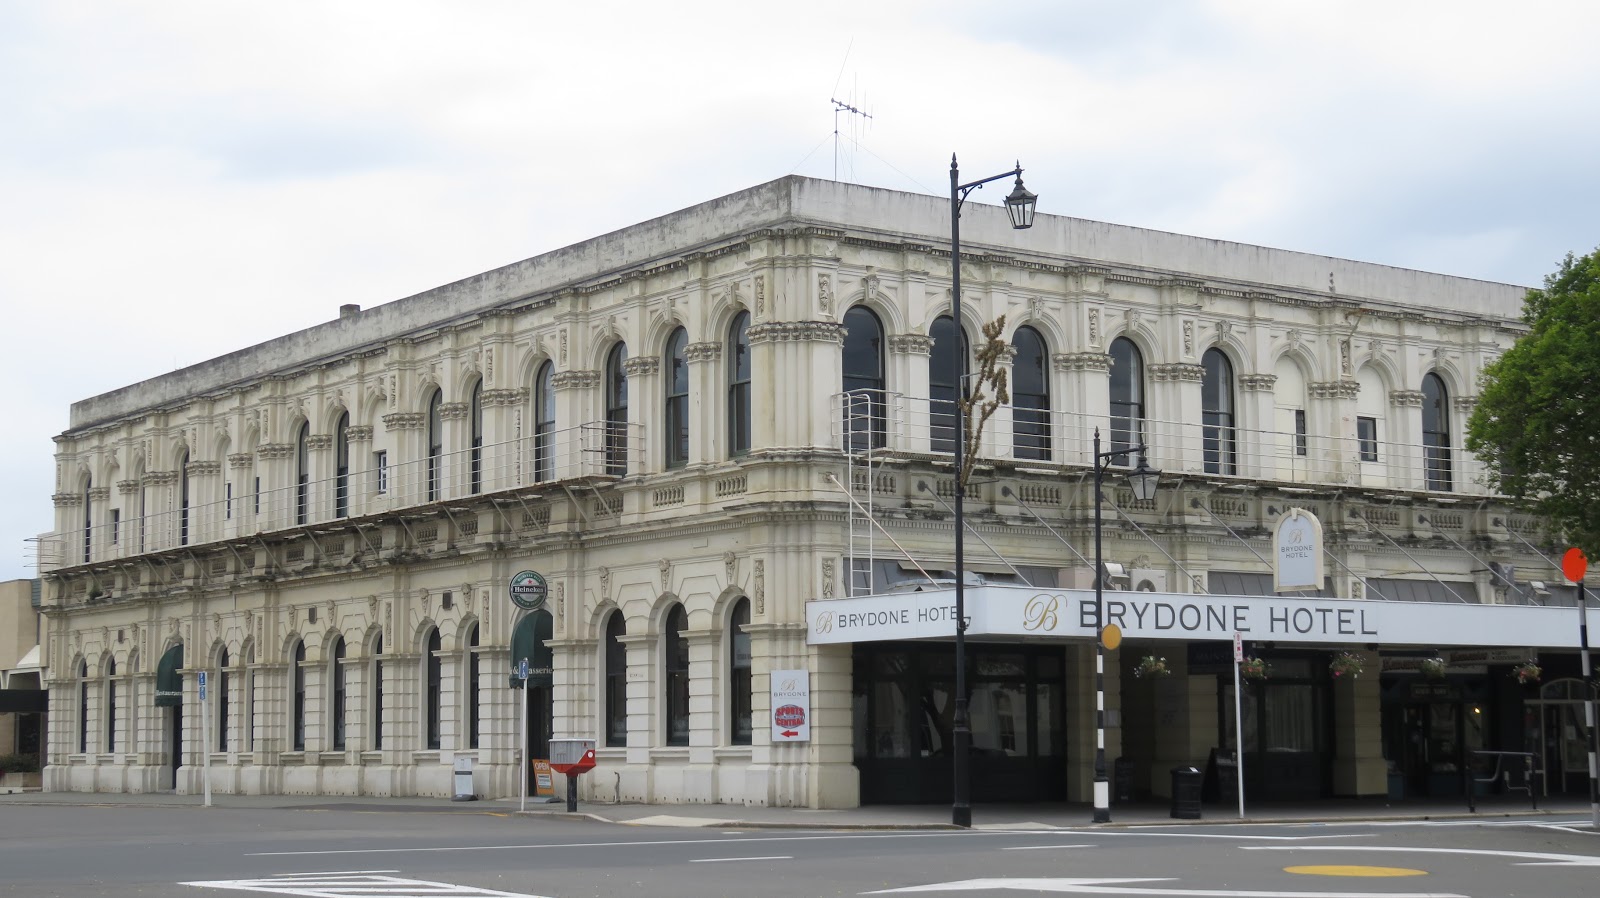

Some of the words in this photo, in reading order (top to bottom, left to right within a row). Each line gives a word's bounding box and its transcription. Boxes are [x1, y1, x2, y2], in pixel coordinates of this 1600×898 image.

[838, 610, 909, 628] BRYDONE
[918, 606, 958, 622] HOTE
[1080, 600, 1250, 632] BRYDONE
[1269, 606, 1378, 636] HOTEL
[776, 706, 804, 716] SPORTS
[775, 717, 805, 726] CENTRAL
